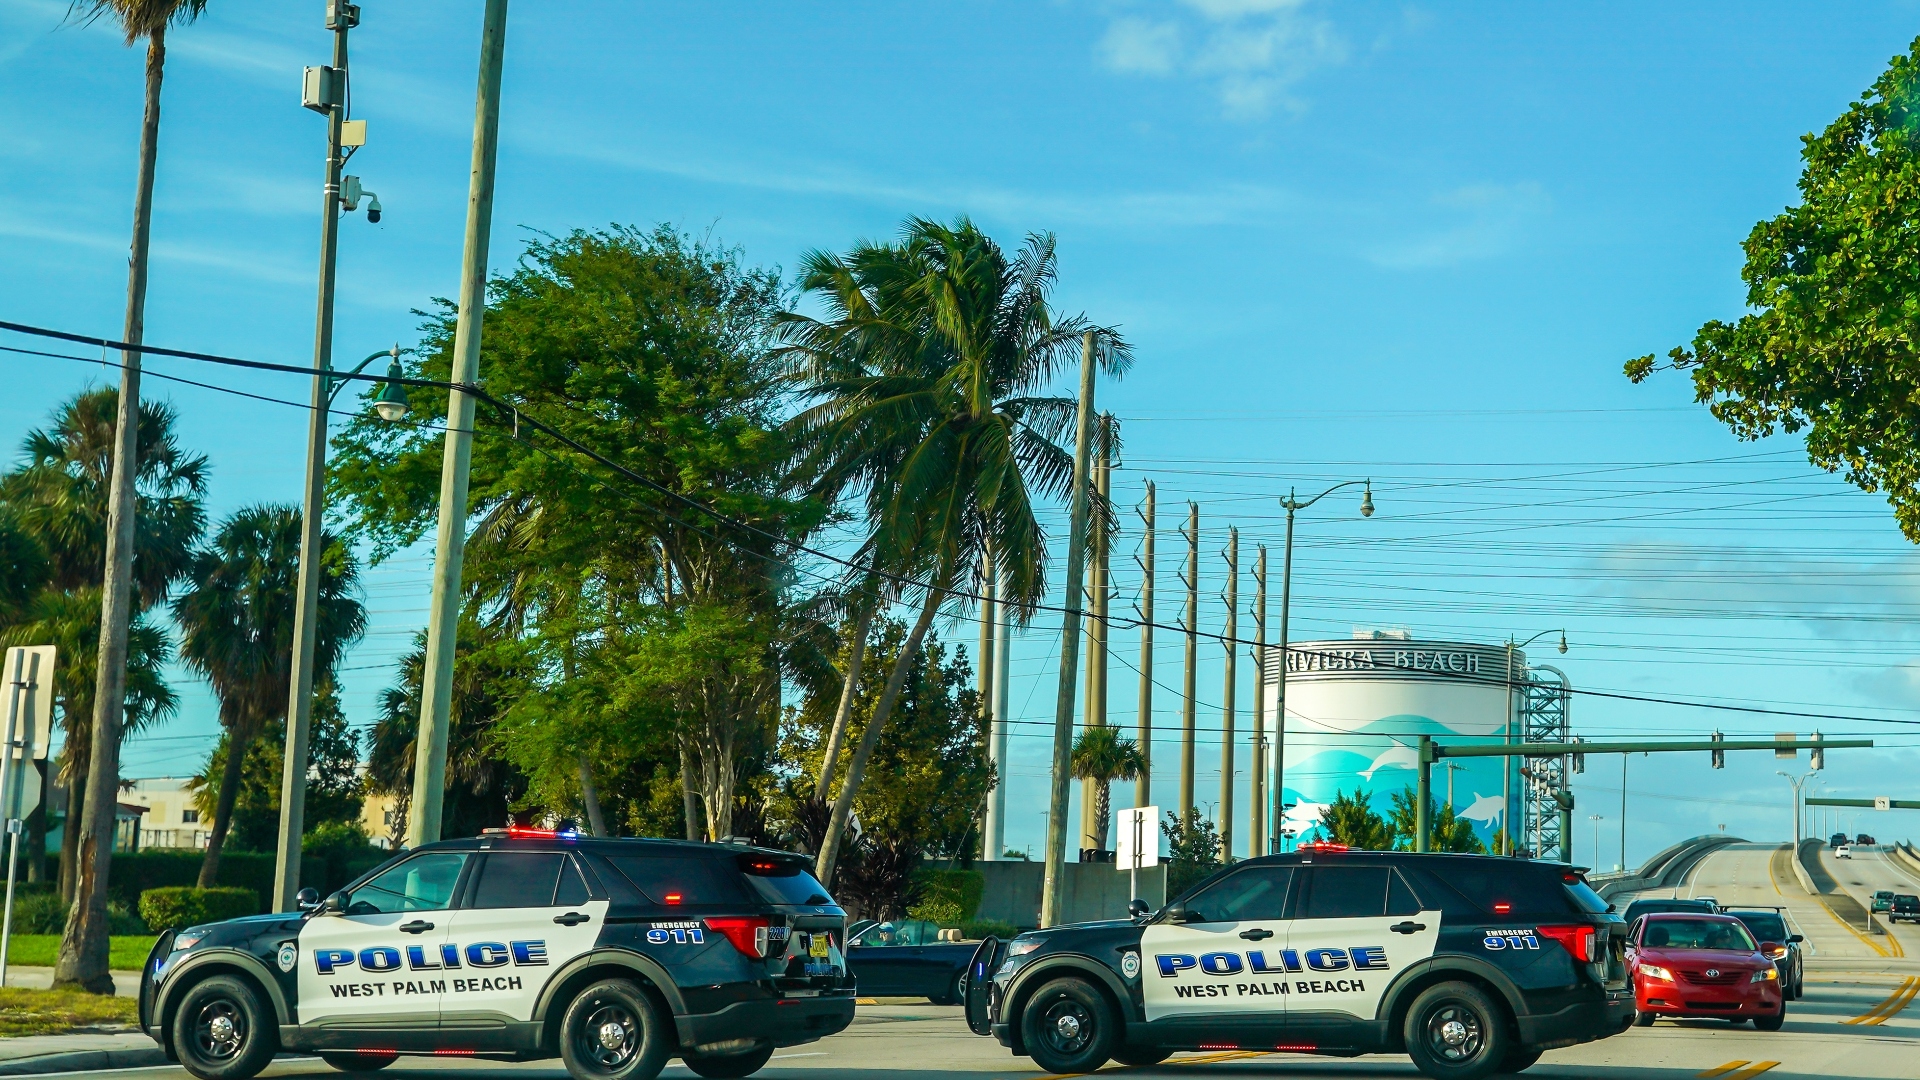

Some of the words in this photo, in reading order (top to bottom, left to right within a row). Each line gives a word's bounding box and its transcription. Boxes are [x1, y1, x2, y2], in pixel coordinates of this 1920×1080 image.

[1394, 650, 1480, 673] BEACH
[651, 921, 700, 929] EMERGENCY
[646, 929, 704, 944] 911
[1483, 935, 1540, 950] 911
[313, 939, 549, 975] POLICE
[1155, 945, 1390, 978] POLICE
[330, 983, 386, 998] WEST
[393, 980, 447, 995] PALM
[453, 976, 523, 993] BEACH
[1174, 984, 1230, 998] WEST
[1236, 982, 1291, 996] PALM
[1295, 979, 1366, 993] BEACH
